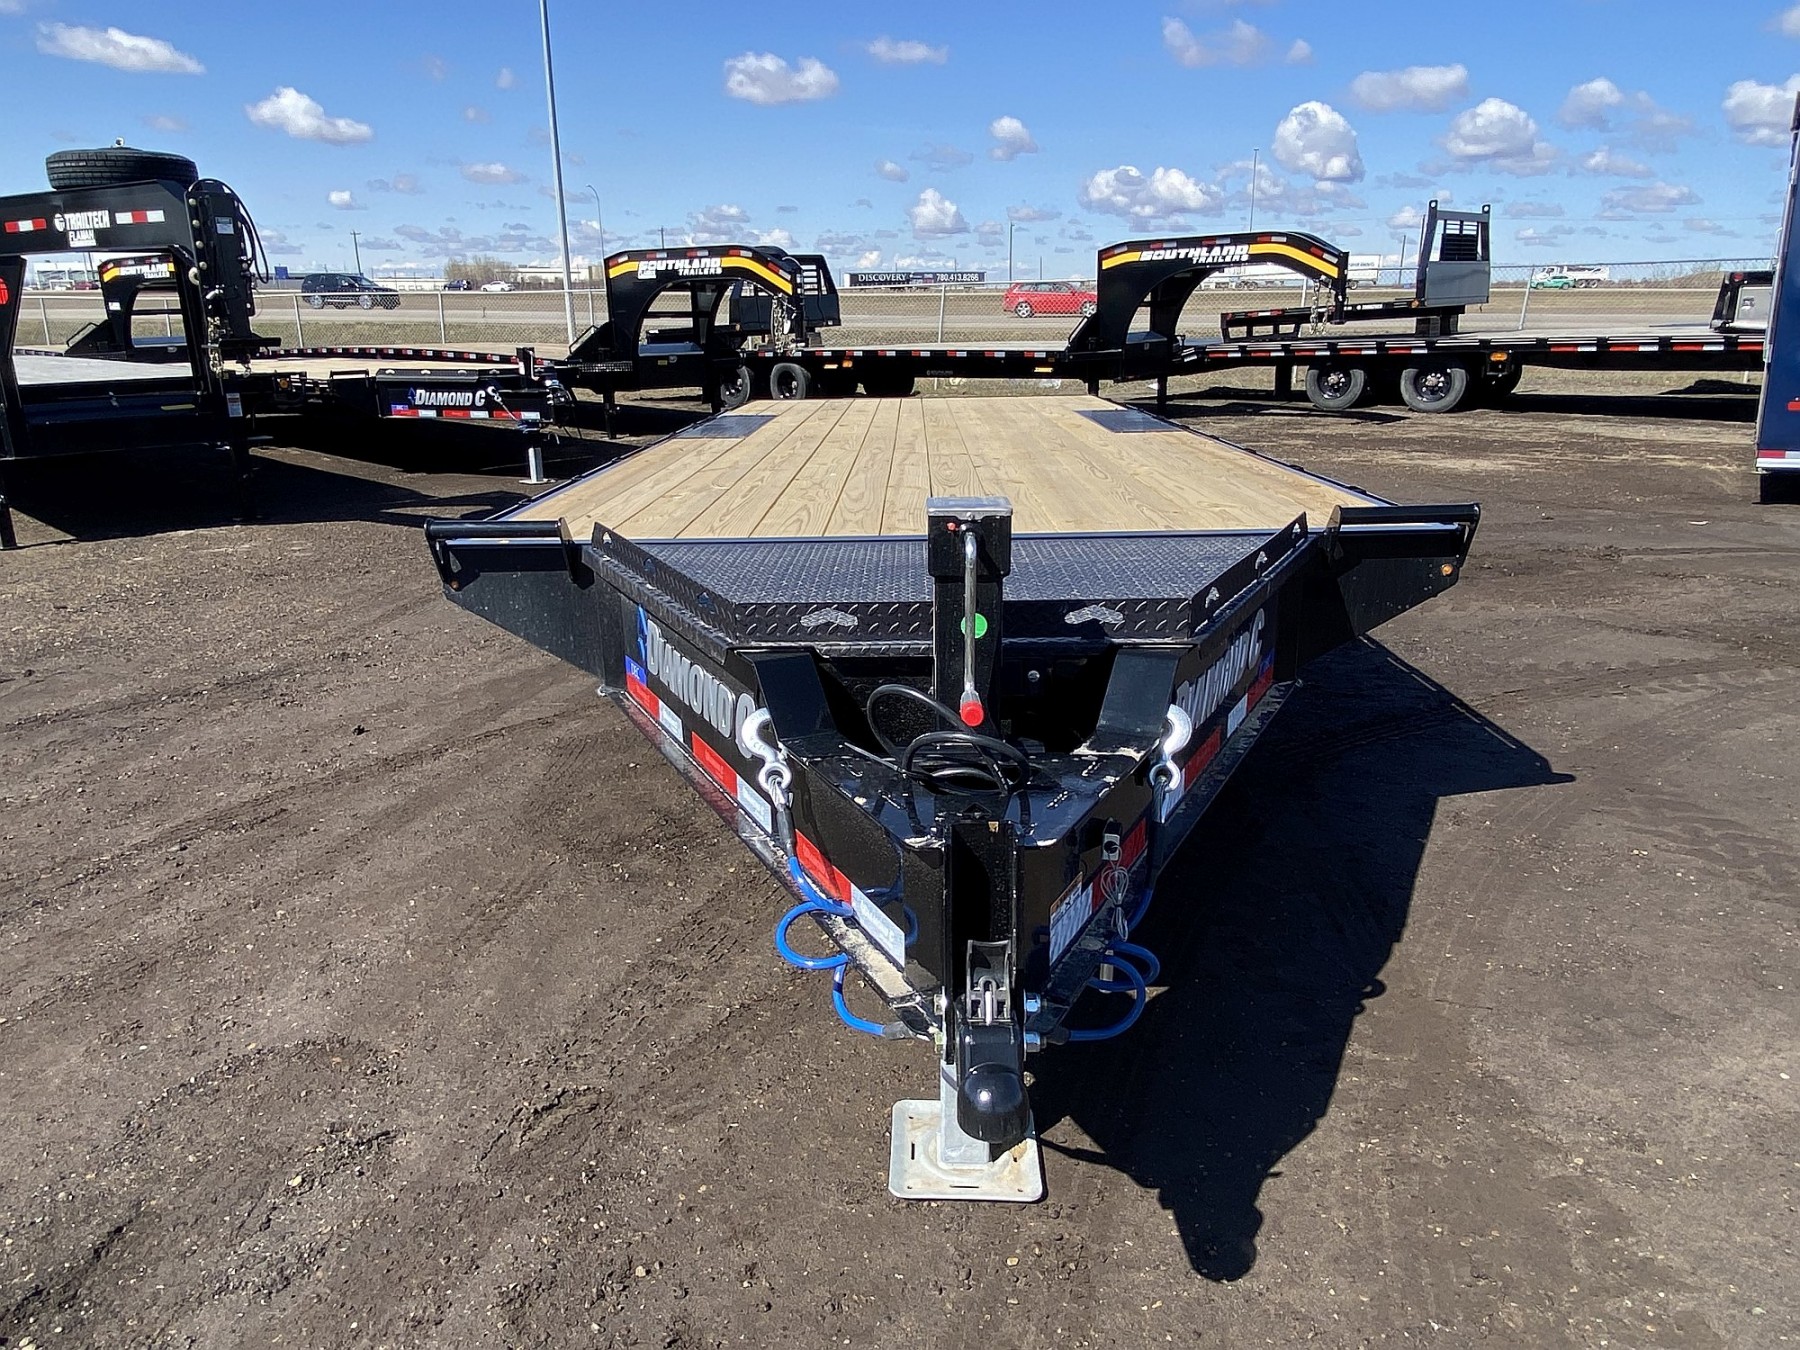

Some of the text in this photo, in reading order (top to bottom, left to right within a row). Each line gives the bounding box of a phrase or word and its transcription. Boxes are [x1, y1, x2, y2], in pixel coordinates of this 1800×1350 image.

[64, 210, 110, 230] TRAILTECH
[1140, 244, 1249, 261] SOUTHLAND
[1192, 254, 1249, 264] TRAILERS
[639, 257, 722, 271] SOUTHLAND
[677, 267, 723, 276] TRAILERS
[858, 273, 907, 282] DISCOVERY
[415, 389, 486, 407] DIAMOND C
[1249, 608, 1265, 671] C
[646, 619, 736, 738] DIAMOND
